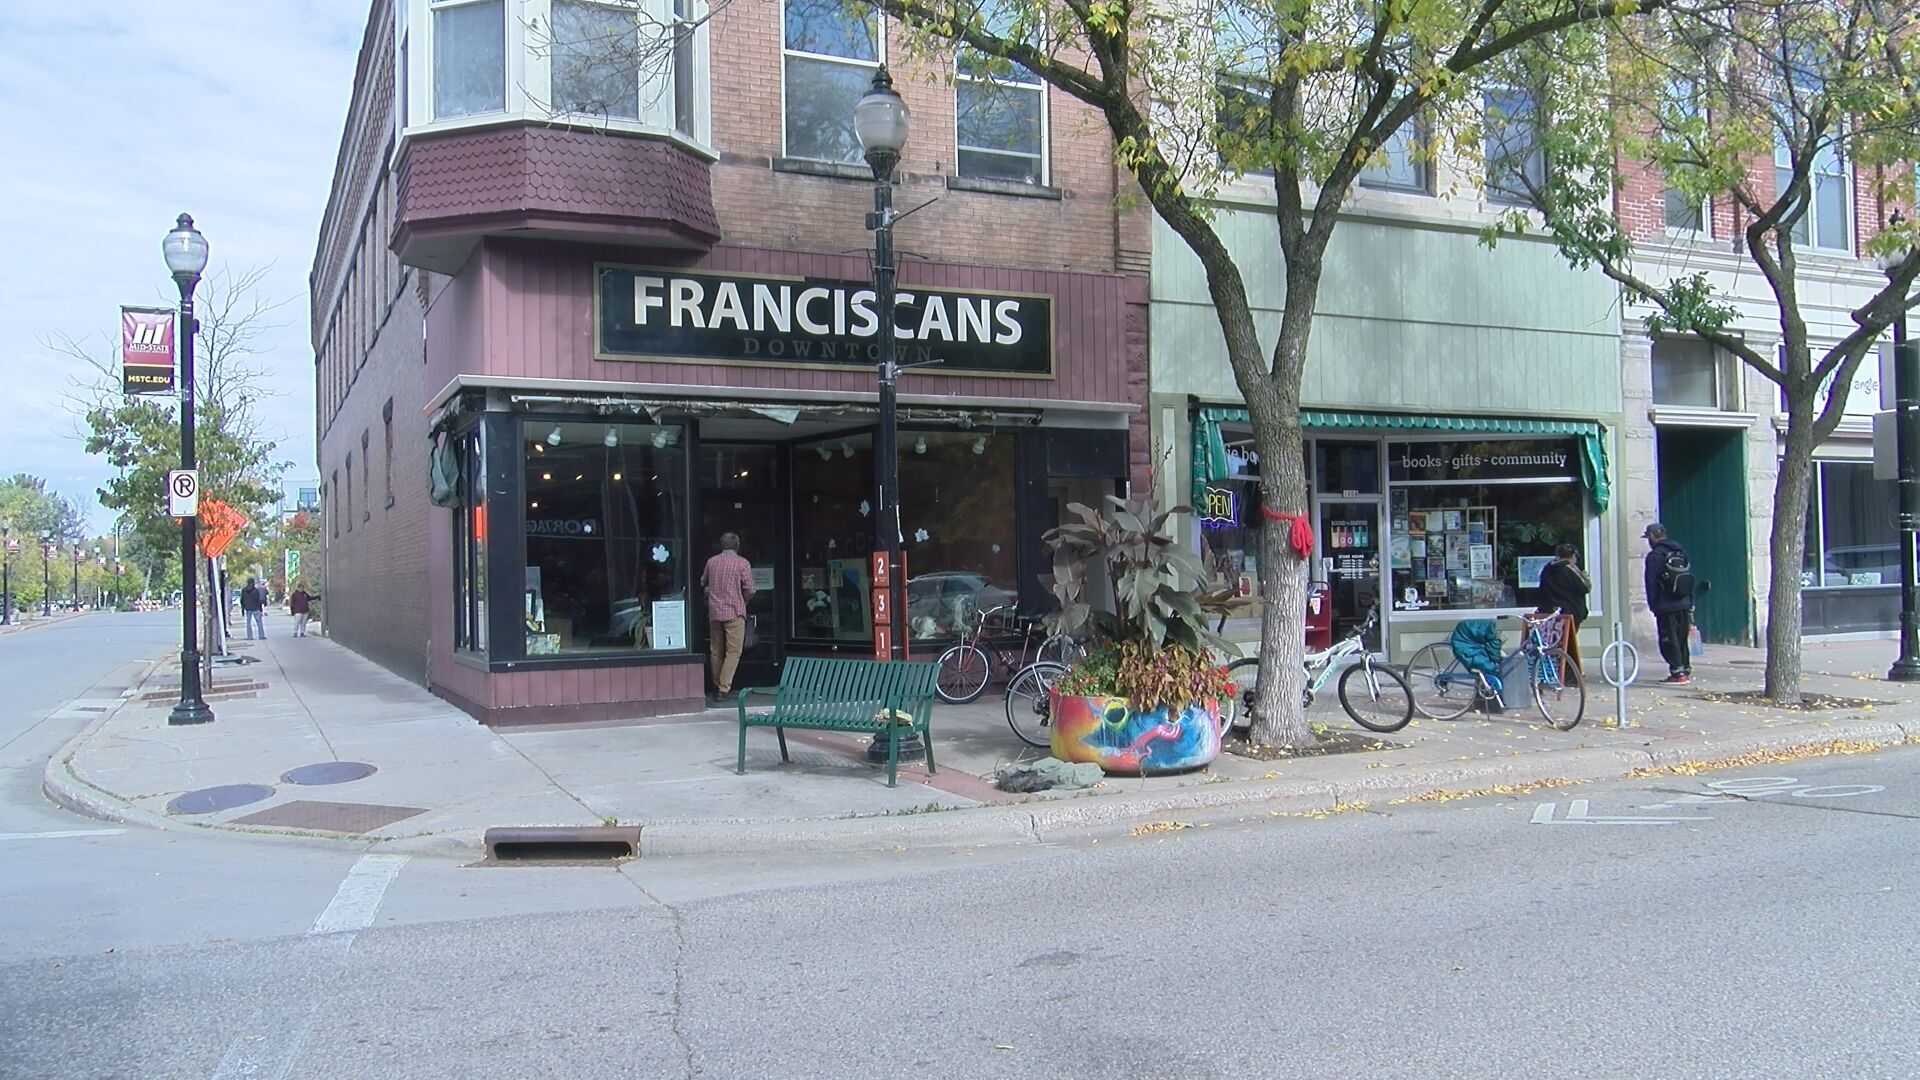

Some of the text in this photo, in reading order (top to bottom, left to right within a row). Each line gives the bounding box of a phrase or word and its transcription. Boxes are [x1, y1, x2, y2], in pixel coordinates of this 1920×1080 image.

[634, 276, 1023, 345] FRANCISCANS
[129, 343, 169, 352] MID-STATE
[743, 337, 932, 362] DOWNTOWN
[127, 375, 171, 384] MSTC.EDU
[1402, 454, 1442, 468] books
[1452, 454, 1481, 469] gifts
[1491, 452, 1567, 467] community
[1205, 493, 1231, 516] PEN
[877, 557, 885, 575] 2
[878, 594, 886, 612] 3
[879, 632, 885, 649] 1
